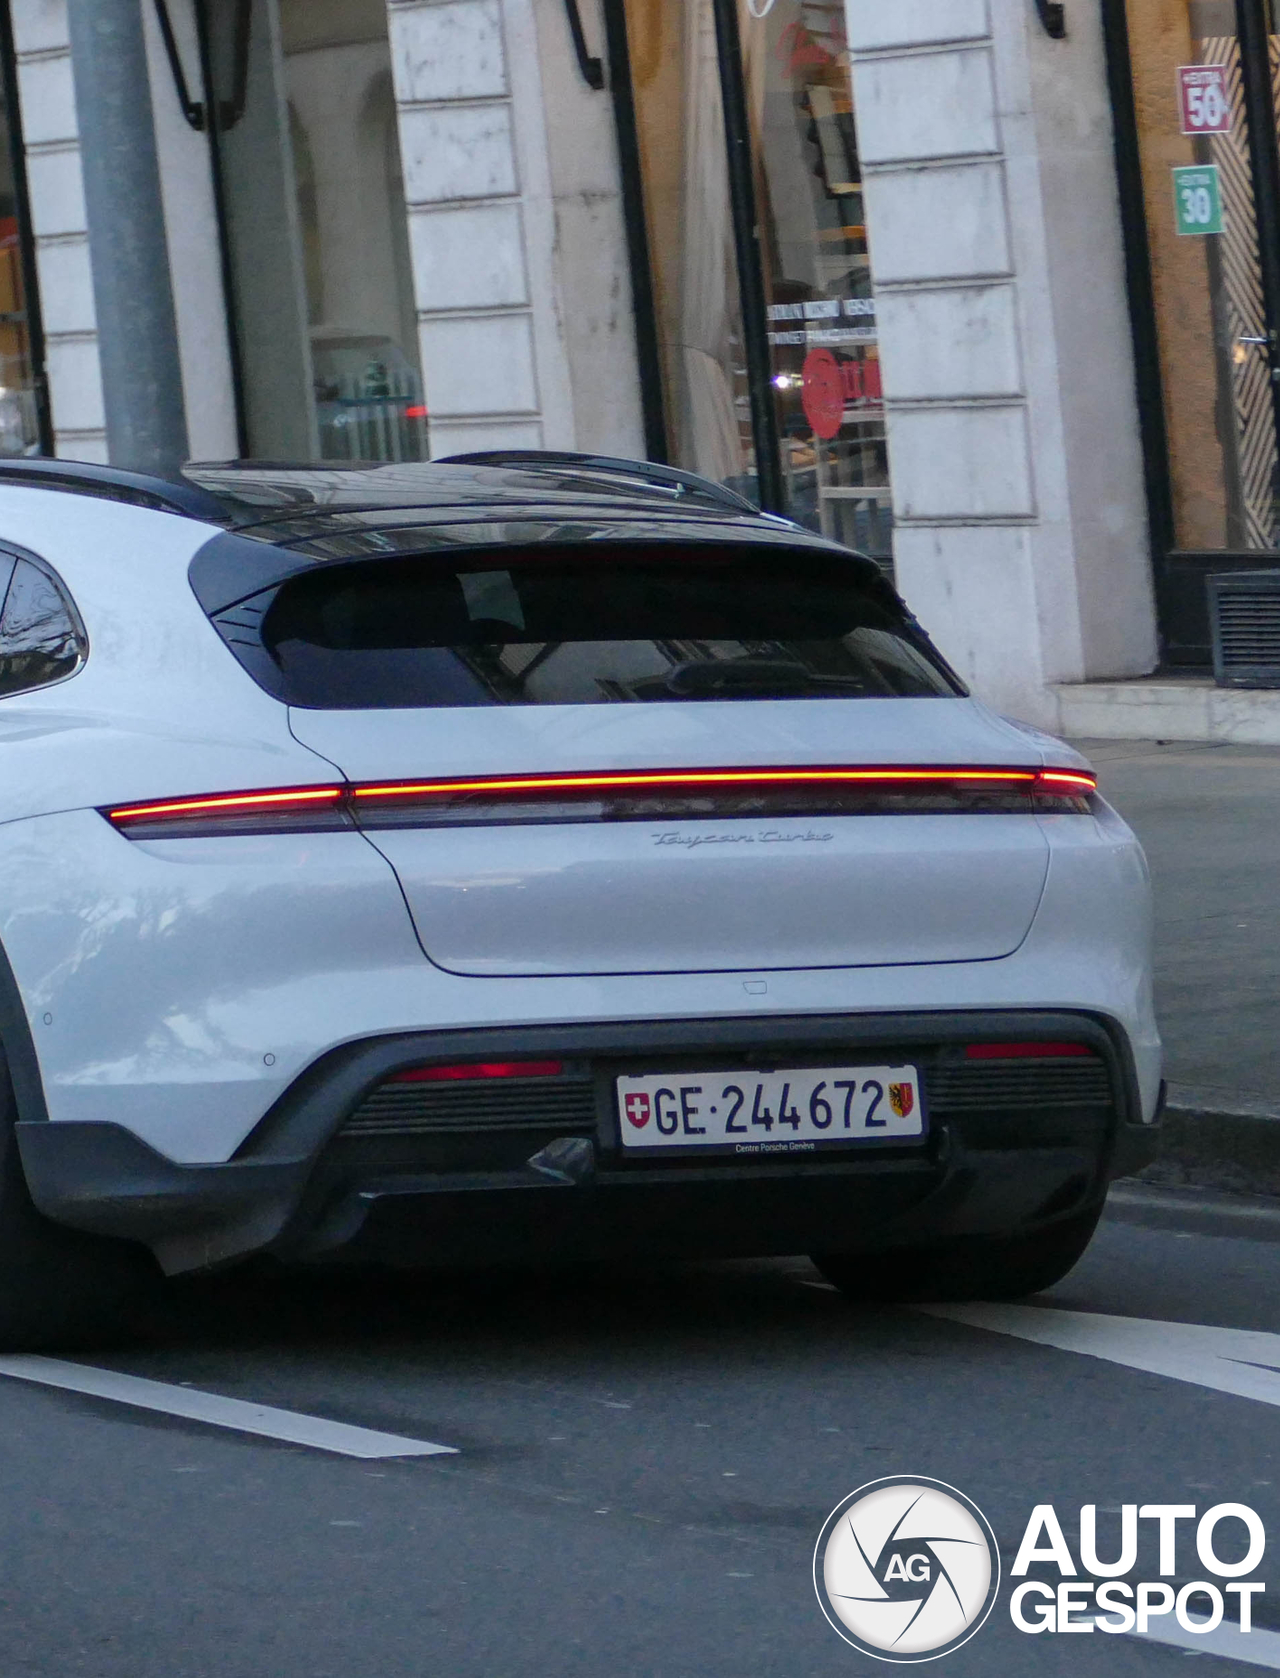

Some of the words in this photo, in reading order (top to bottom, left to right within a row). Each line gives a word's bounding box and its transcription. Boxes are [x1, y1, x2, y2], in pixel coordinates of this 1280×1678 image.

[1181, 187, 1212, 224] 30
[651, 831, 755, 849] Taycan
[758, 829, 835, 843] Turbo
[735, 1143, 759, 1153] Centre
[760, 1142, 788, 1152] Porsche
